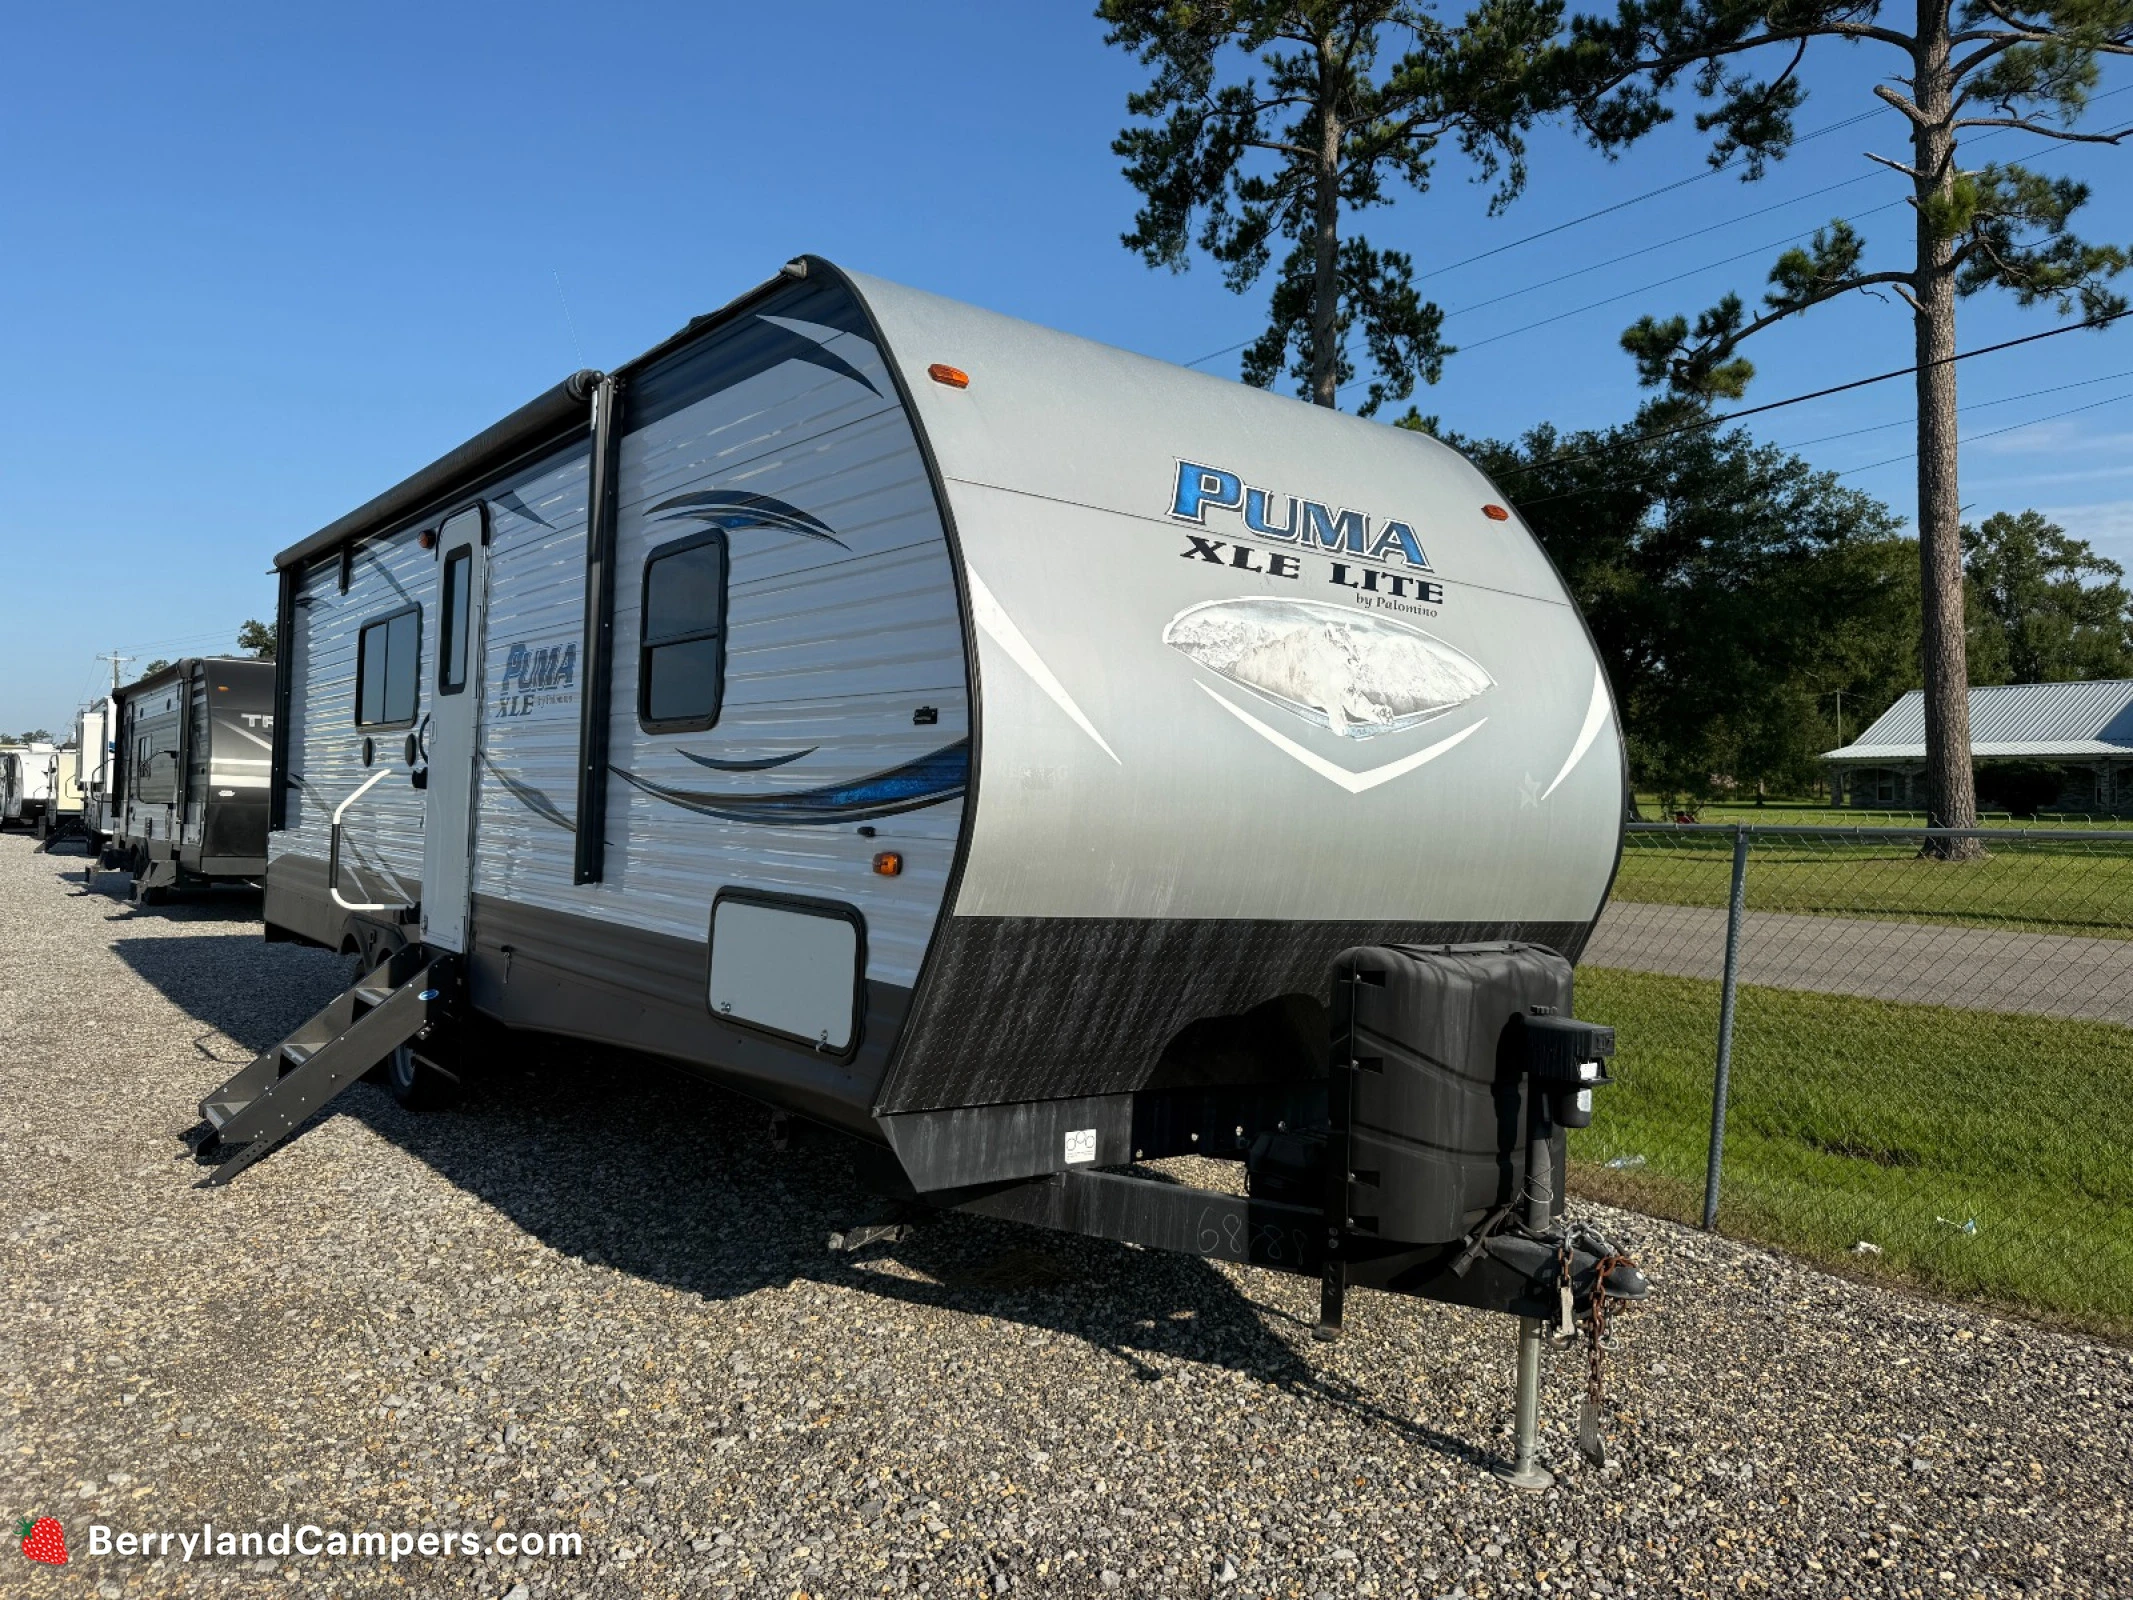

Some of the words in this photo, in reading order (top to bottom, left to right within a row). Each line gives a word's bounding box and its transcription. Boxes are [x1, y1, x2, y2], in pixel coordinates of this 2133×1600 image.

[1166, 456, 1434, 573] PUMA
[1180, 535, 1301, 579] XLE
[1329, 562, 1443, 605] LITE
[1356, 592, 1372, 609] by
[1376, 596, 1438, 618] Palomino
[500, 642, 578, 696] PUMA
[496, 694, 535, 718] XLE
